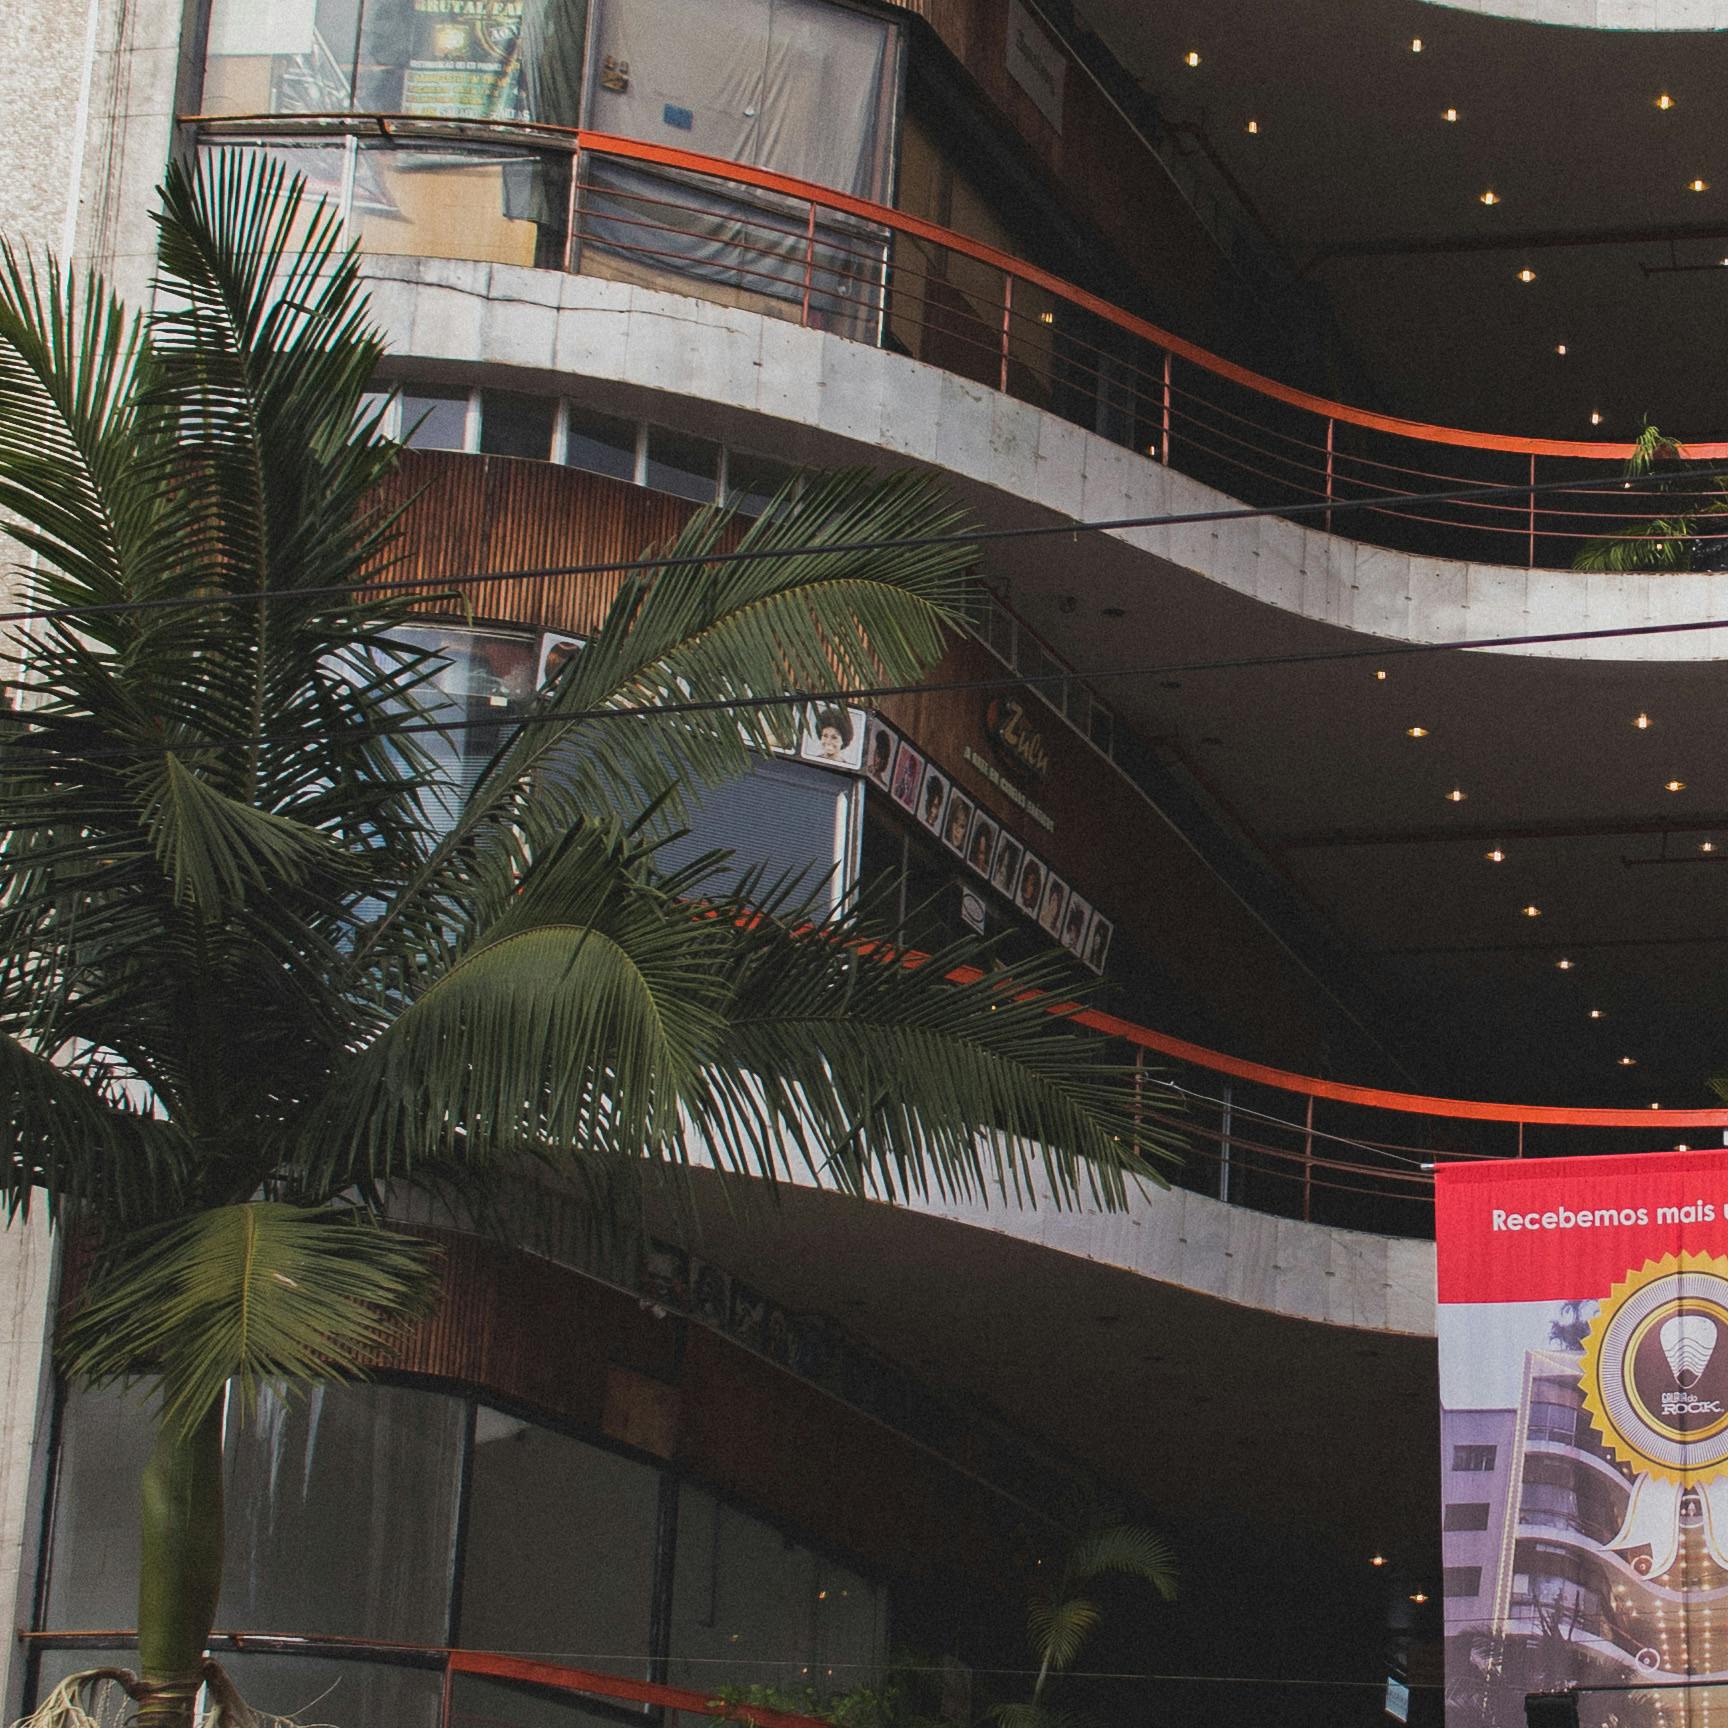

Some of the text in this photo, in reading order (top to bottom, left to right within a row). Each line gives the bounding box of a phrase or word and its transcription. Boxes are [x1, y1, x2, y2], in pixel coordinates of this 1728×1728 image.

[1491, 1206, 1649, 1232] Recebemos
[1655, 1198, 1716, 1225] mais
[1661, 1400, 1721, 1415] ROCK
